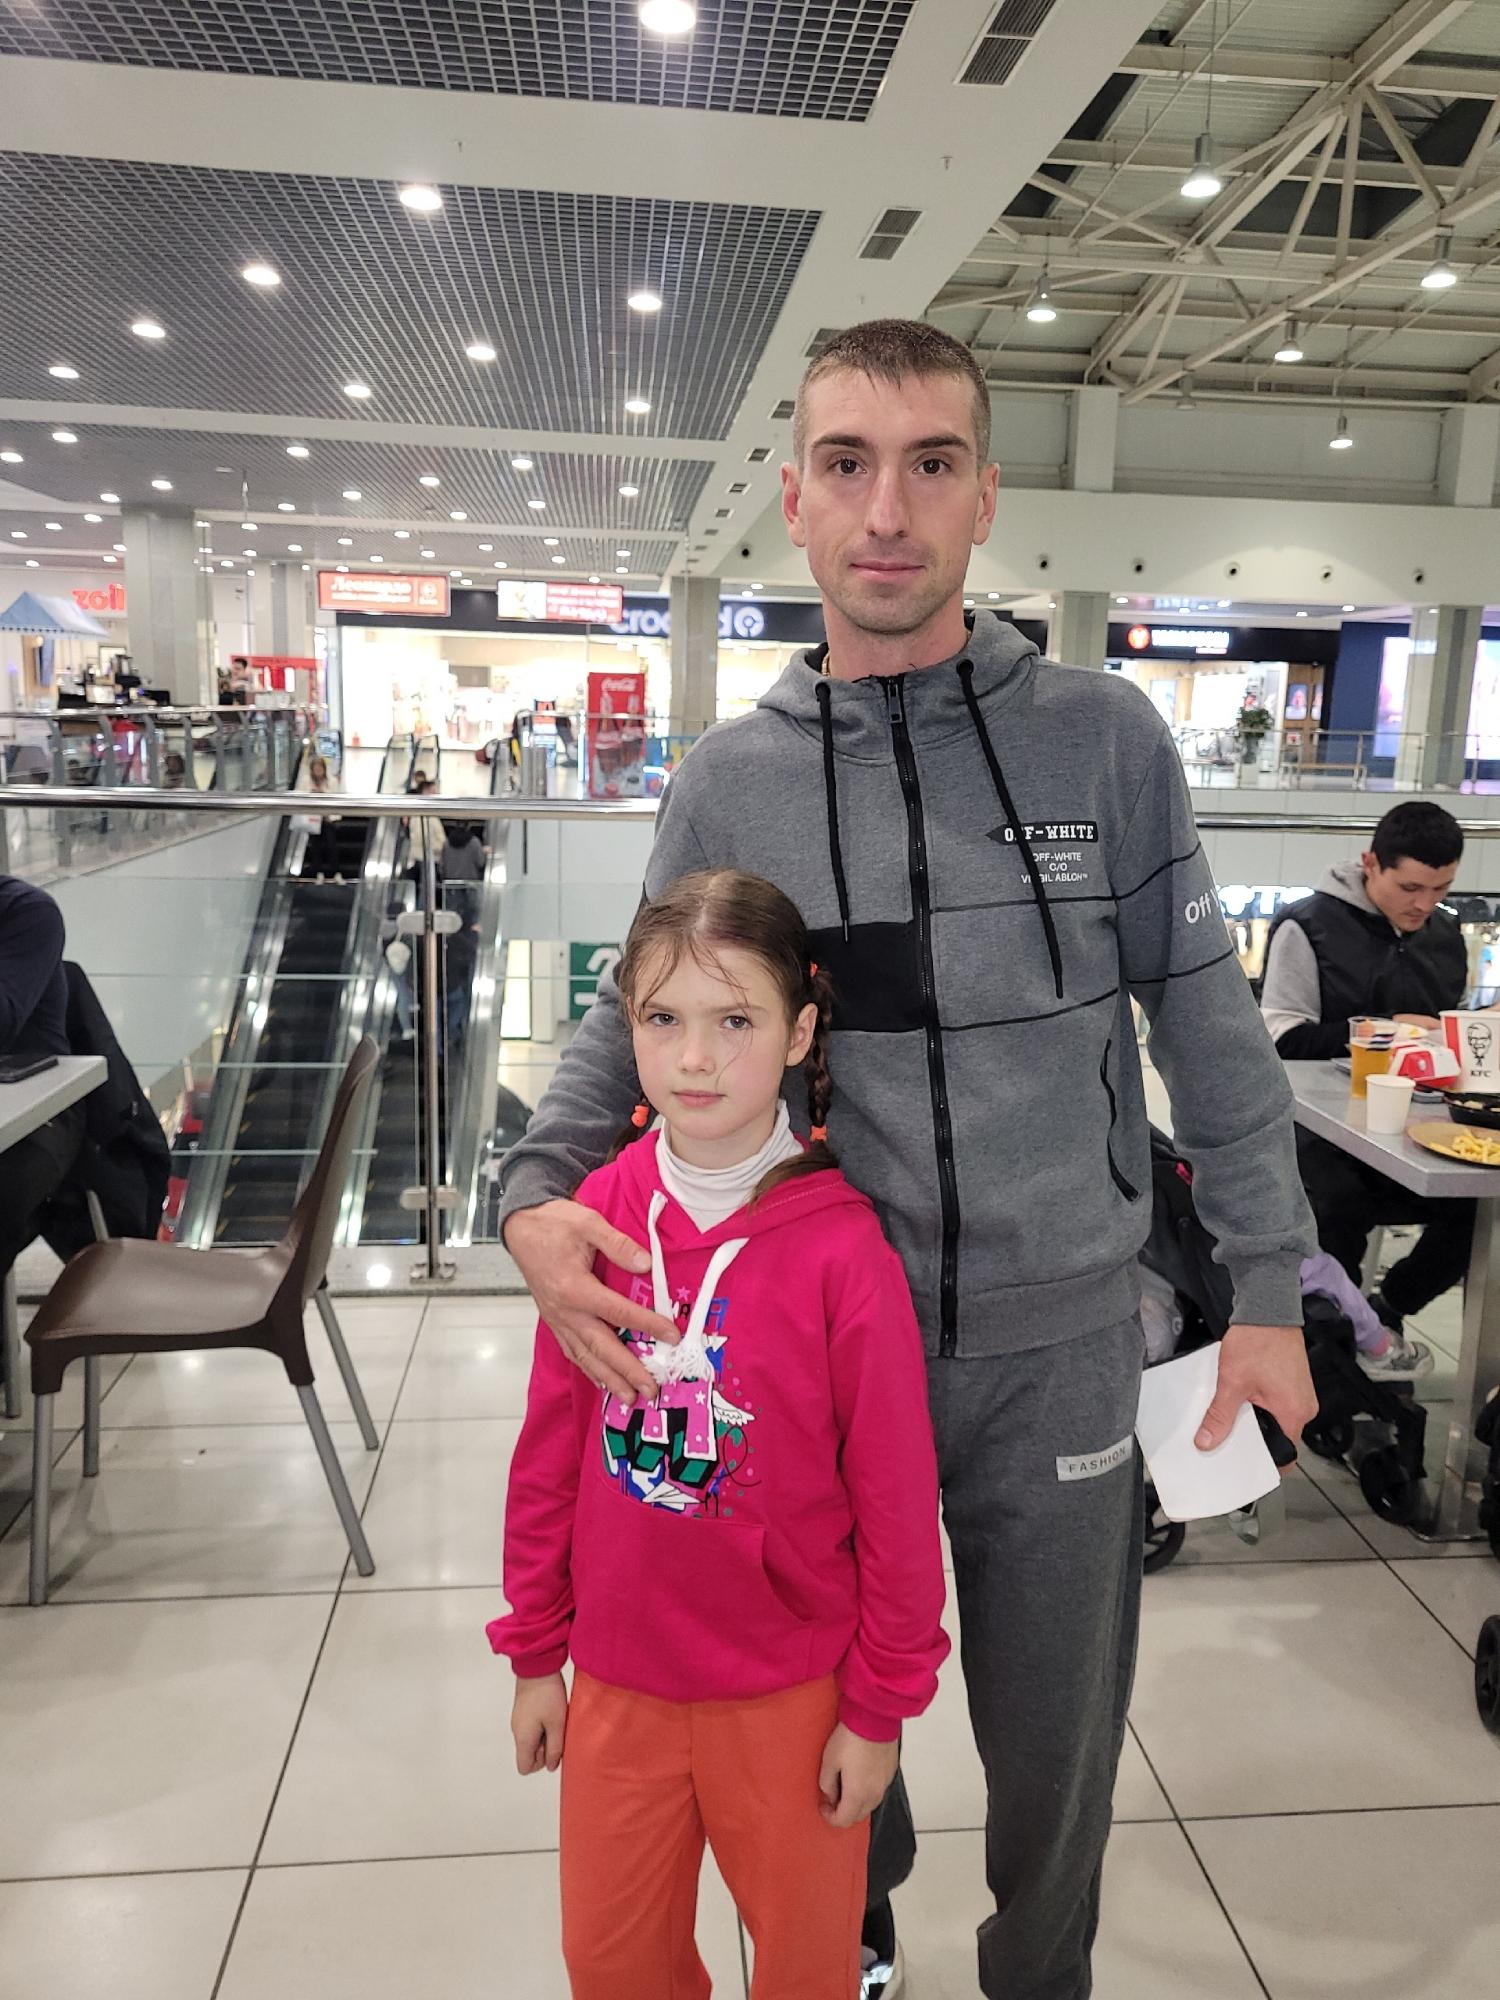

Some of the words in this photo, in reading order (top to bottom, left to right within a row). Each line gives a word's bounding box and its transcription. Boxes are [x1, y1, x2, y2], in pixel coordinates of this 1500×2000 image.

[1004, 824, 1094, 842] OF-WHITE
[1048, 862, 1068, 872] C/O
[1021, 874, 1054, 884] VIGIL
[1185, 892, 1212, 924] Off
[1068, 1446, 1126, 1474] FASHION
